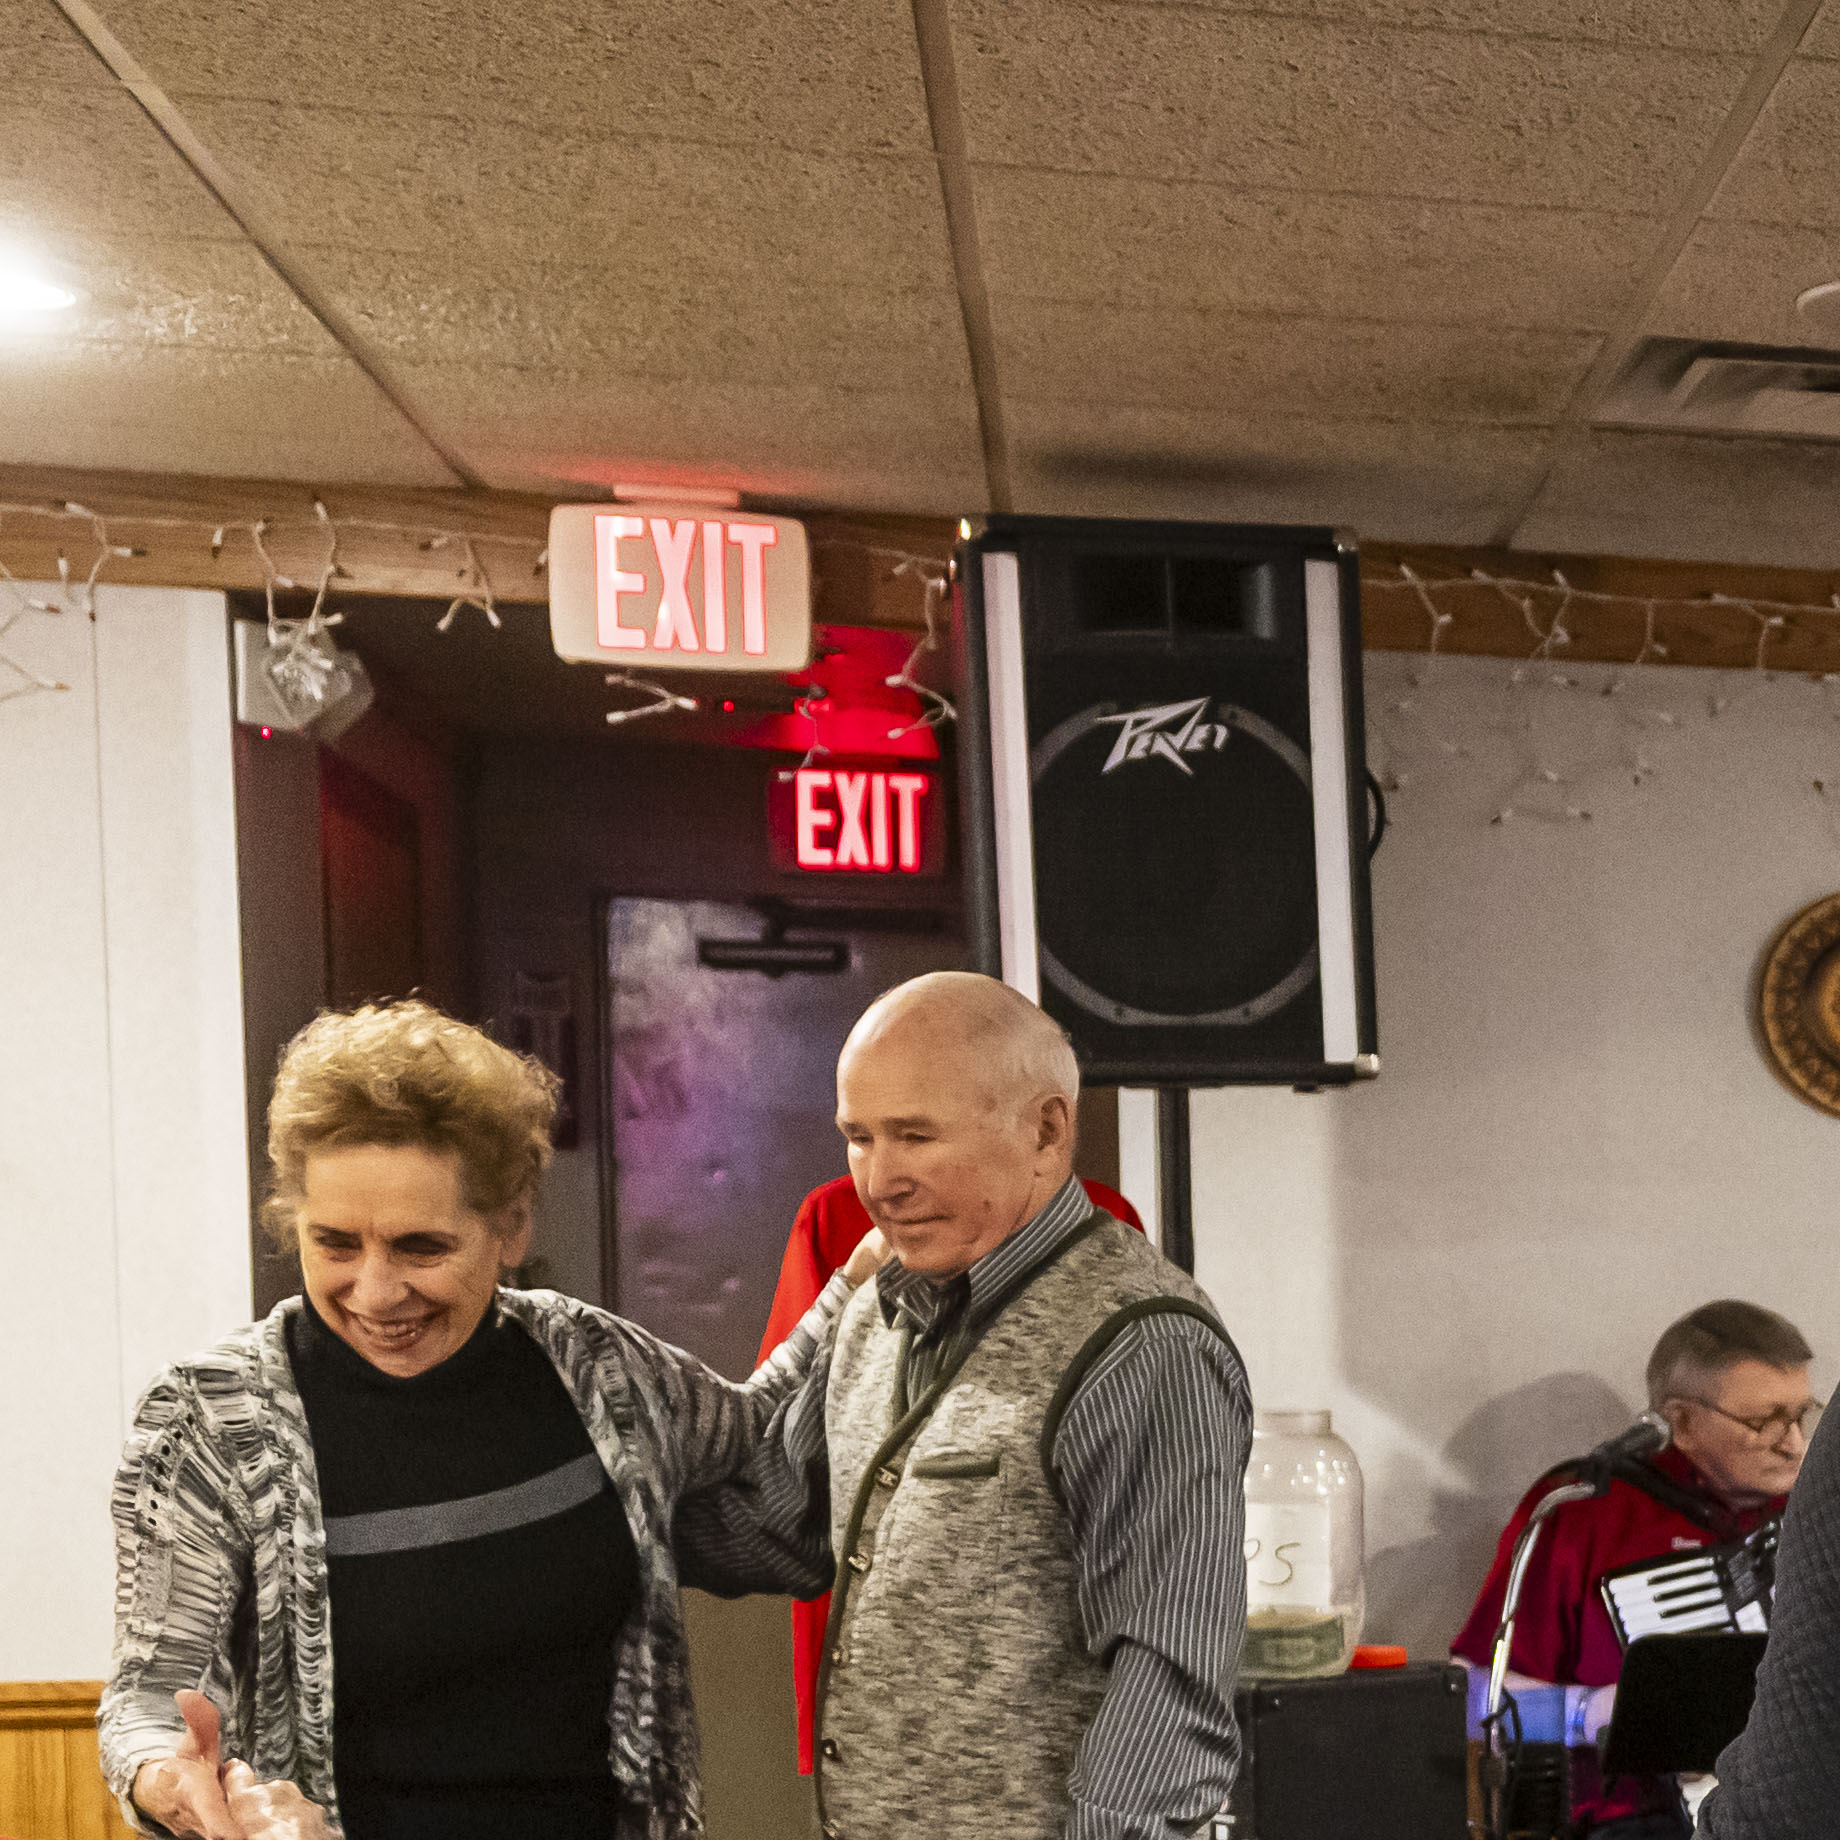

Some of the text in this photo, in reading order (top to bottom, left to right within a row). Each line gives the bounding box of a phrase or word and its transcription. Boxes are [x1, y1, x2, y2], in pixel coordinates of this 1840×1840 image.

[593, 514, 779, 656] EXIT
[1096, 696, 1229, 776] PEAVEY
[796, 768, 928, 874] EXIT
